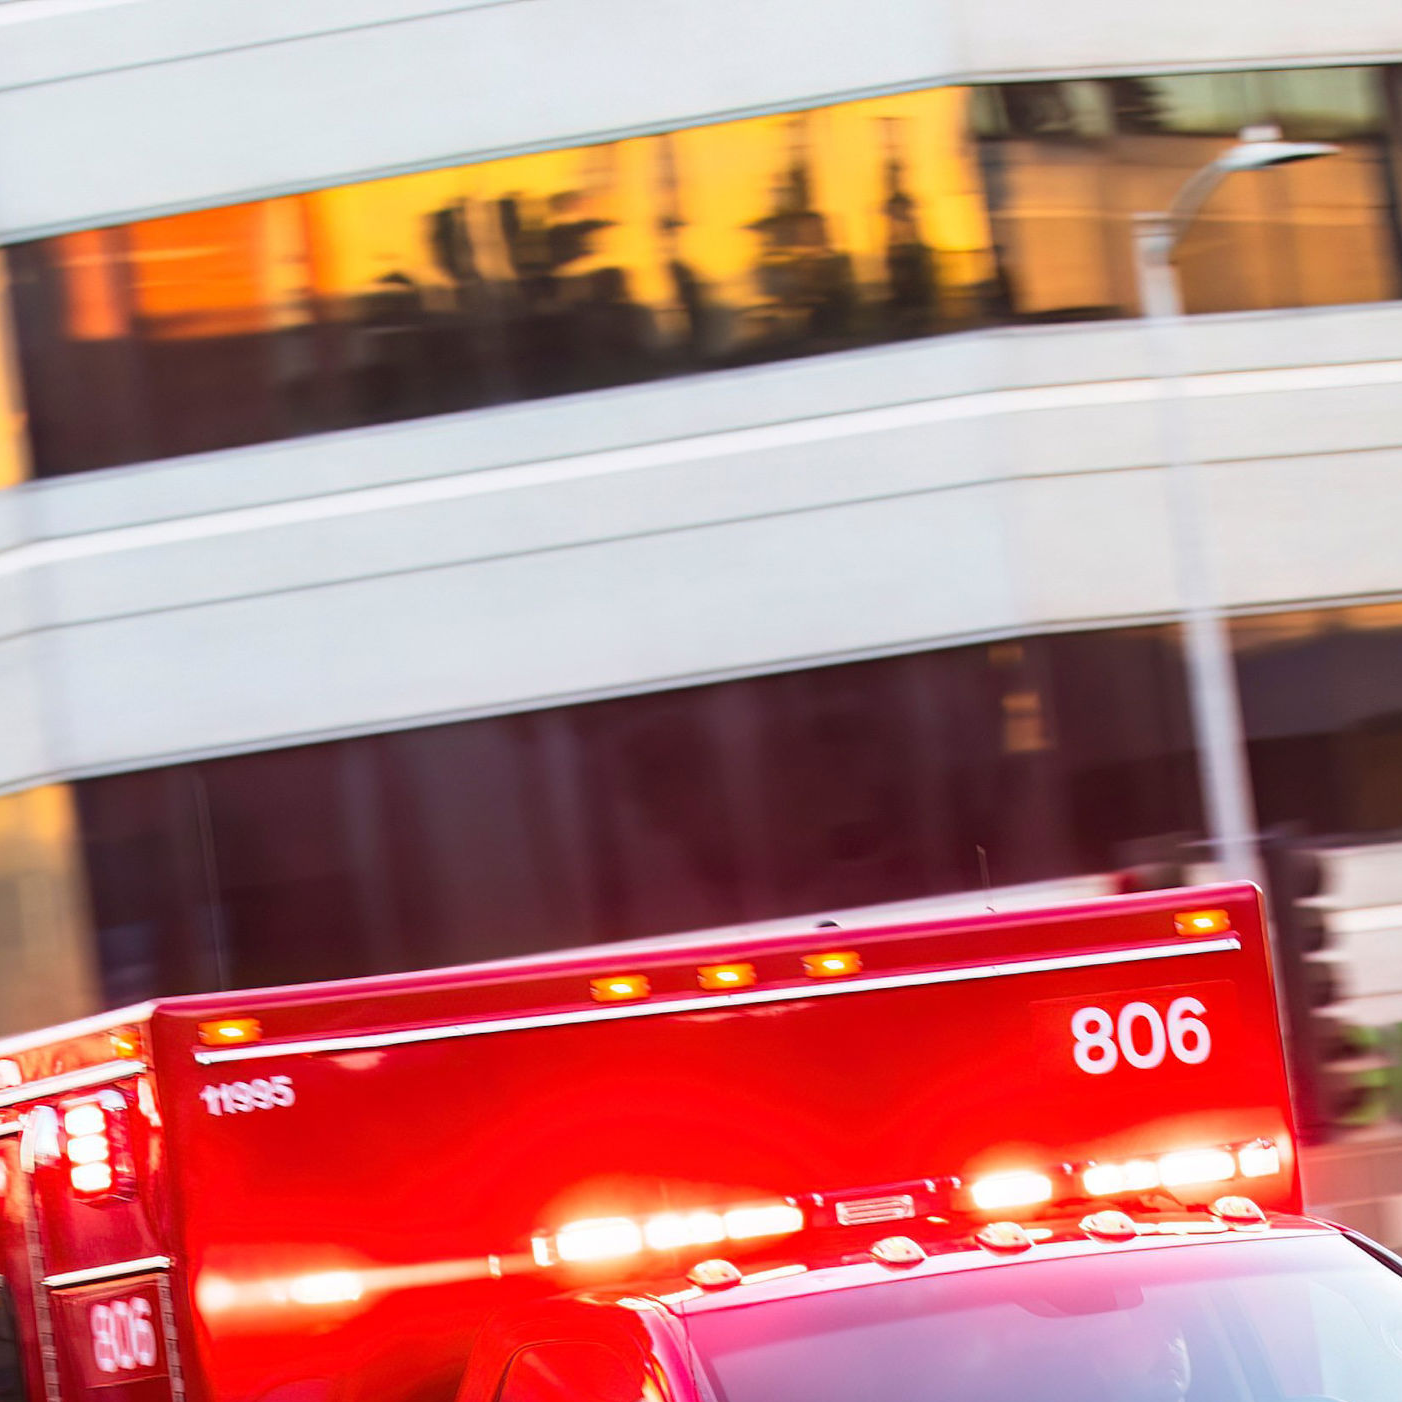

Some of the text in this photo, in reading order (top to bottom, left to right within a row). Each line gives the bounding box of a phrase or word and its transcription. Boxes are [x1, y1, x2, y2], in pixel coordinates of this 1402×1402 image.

[1070, 996, 1212, 1075] 806
[198, 1074, 296, 1117] 11995
[90, 1295, 157, 1374] 806
